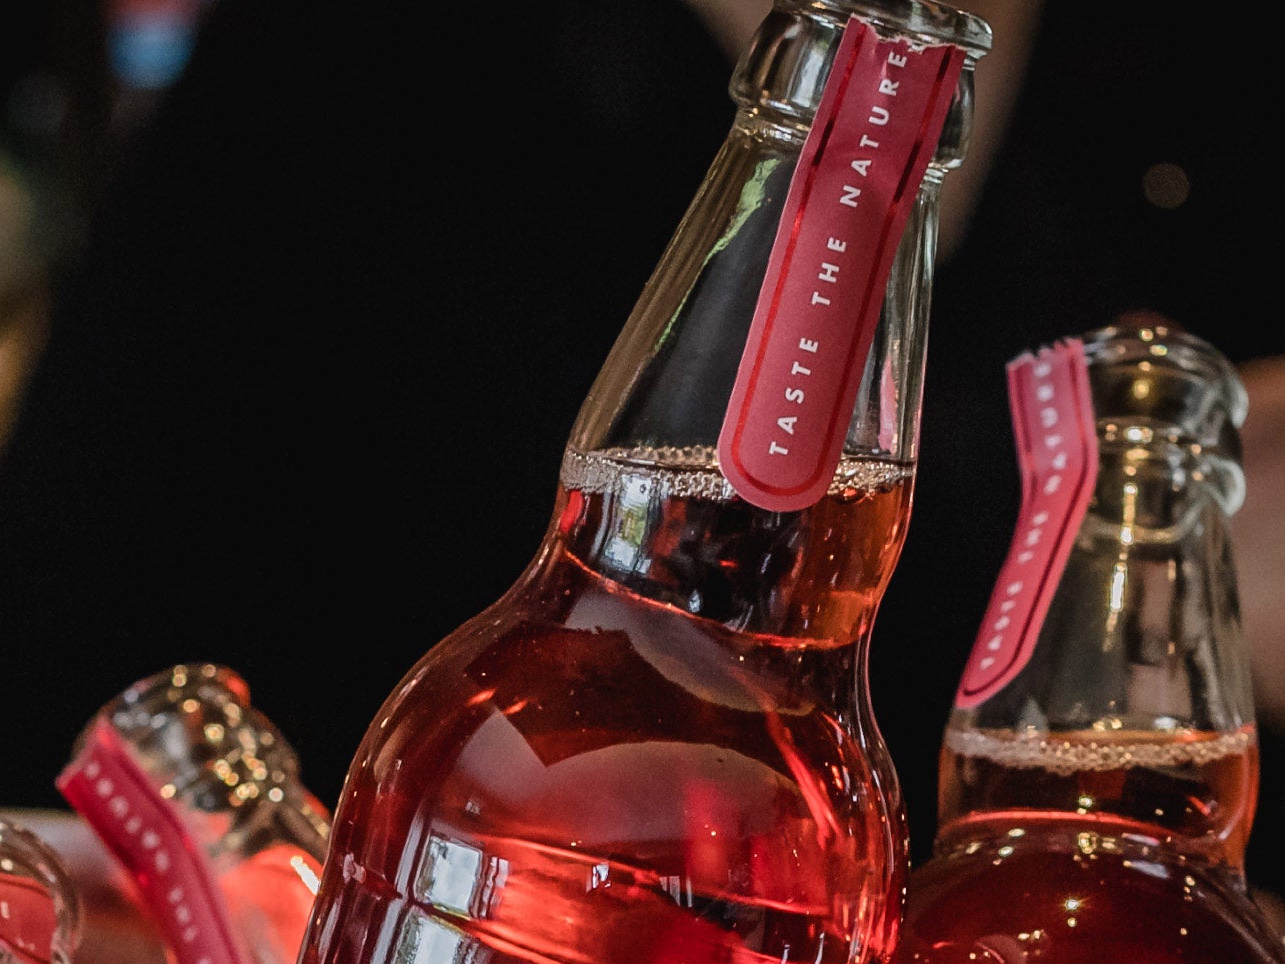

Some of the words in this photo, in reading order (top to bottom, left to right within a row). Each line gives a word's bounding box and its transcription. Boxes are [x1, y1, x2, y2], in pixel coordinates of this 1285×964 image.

[769, 336, 819, 456] TASTE
[812, 237, 847, 306] THE
[840, 50, 908, 209] NATURE
